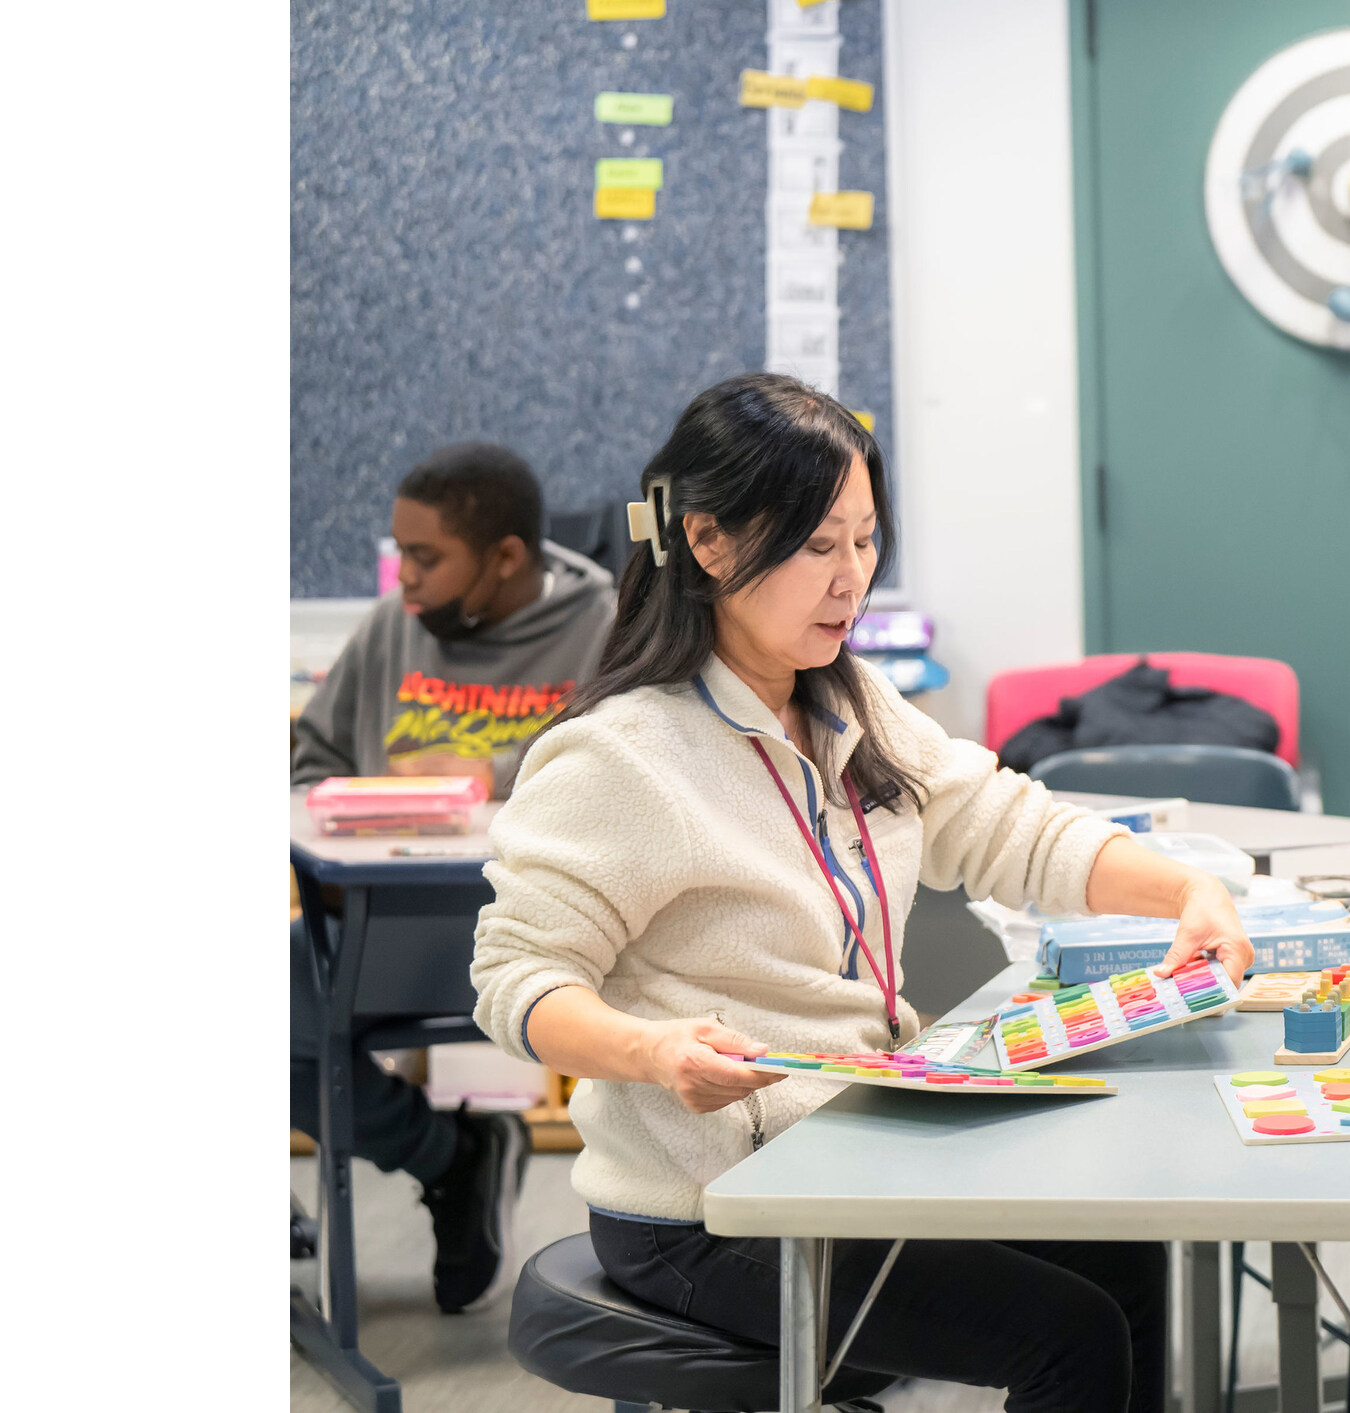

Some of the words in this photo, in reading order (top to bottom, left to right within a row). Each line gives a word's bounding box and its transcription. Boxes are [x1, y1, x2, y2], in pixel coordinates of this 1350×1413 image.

[1083, 952, 1091, 962] 3
[1093, 951, 1106, 961] IN
[1117, 948, 1168, 960] WOODEN
[1084, 961, 1143, 975] ALPHABET
